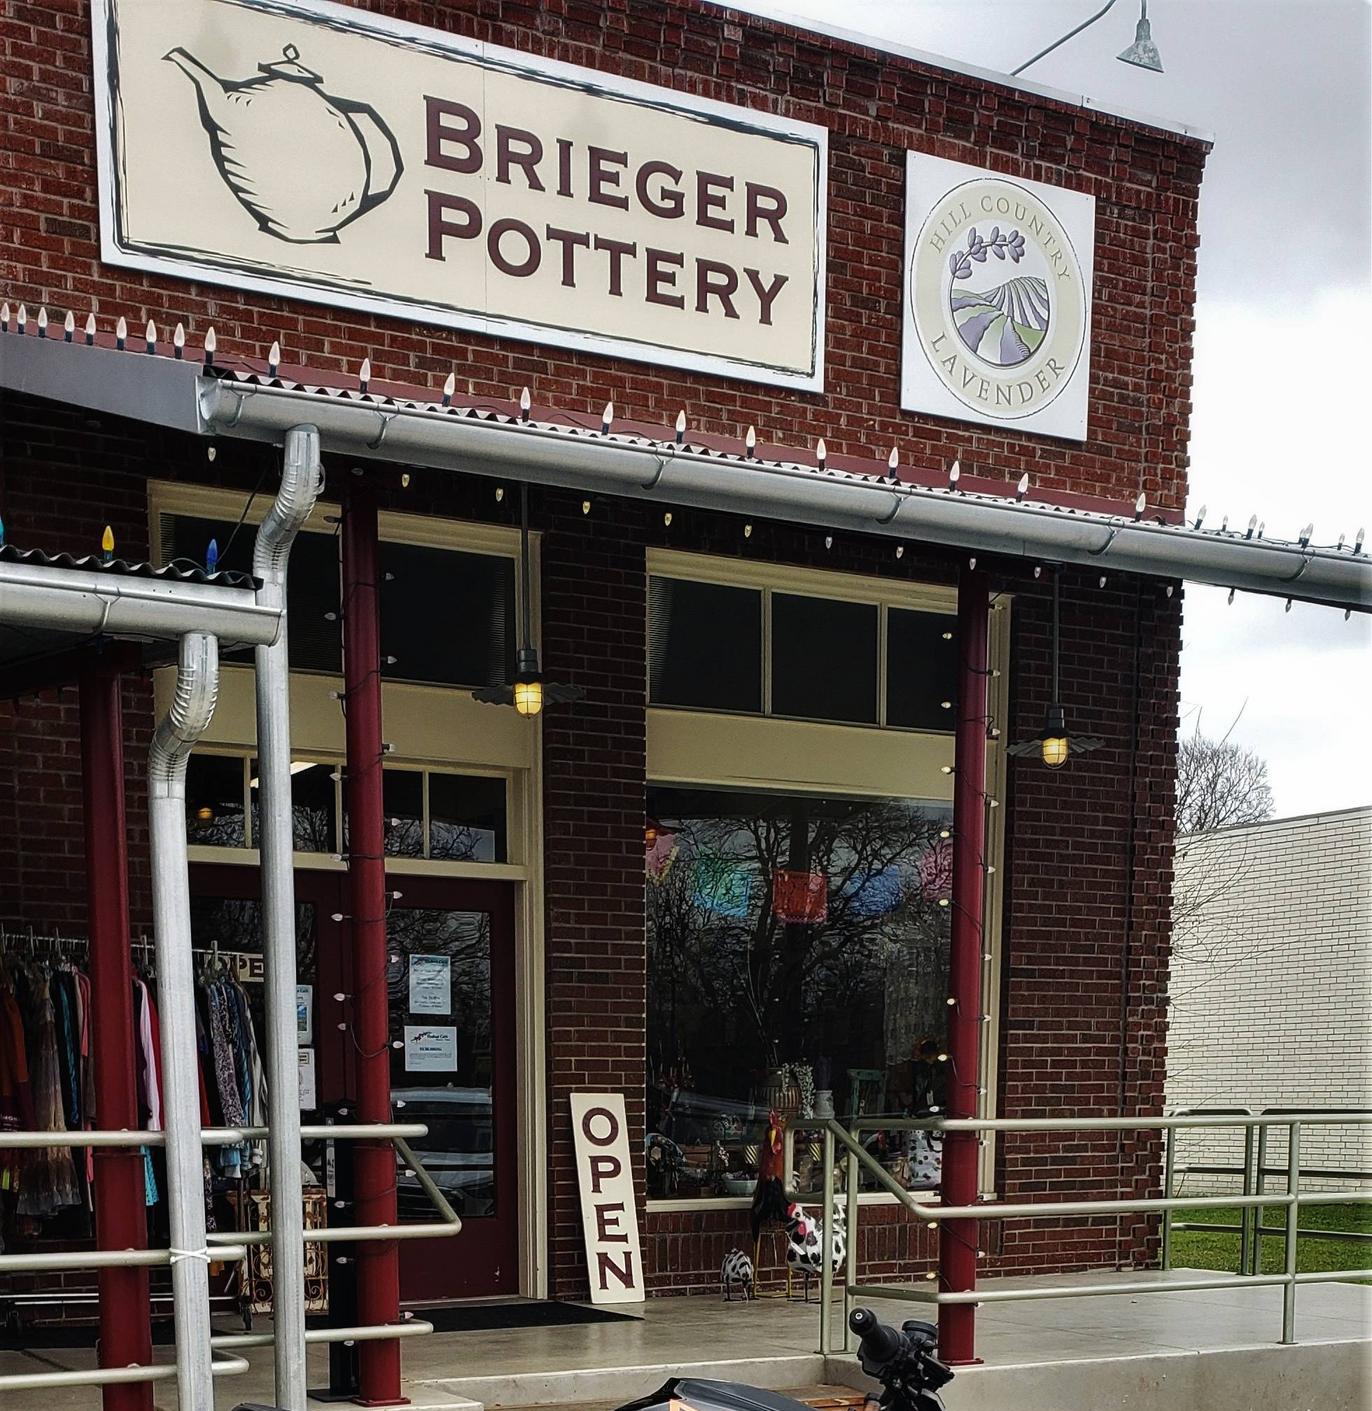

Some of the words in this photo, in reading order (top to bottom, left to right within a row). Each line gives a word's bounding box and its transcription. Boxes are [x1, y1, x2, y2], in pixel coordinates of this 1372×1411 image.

[423, 94, 790, 245] BRIEGER
[929, 202, 972, 254] HILL
[980, 195, 1071, 281] COUNTRY
[424, 188, 790, 326] POTTERY
[930, 331, 1066, 406] LAVENDER
[581, 1106, 635, 1290] OPEN
